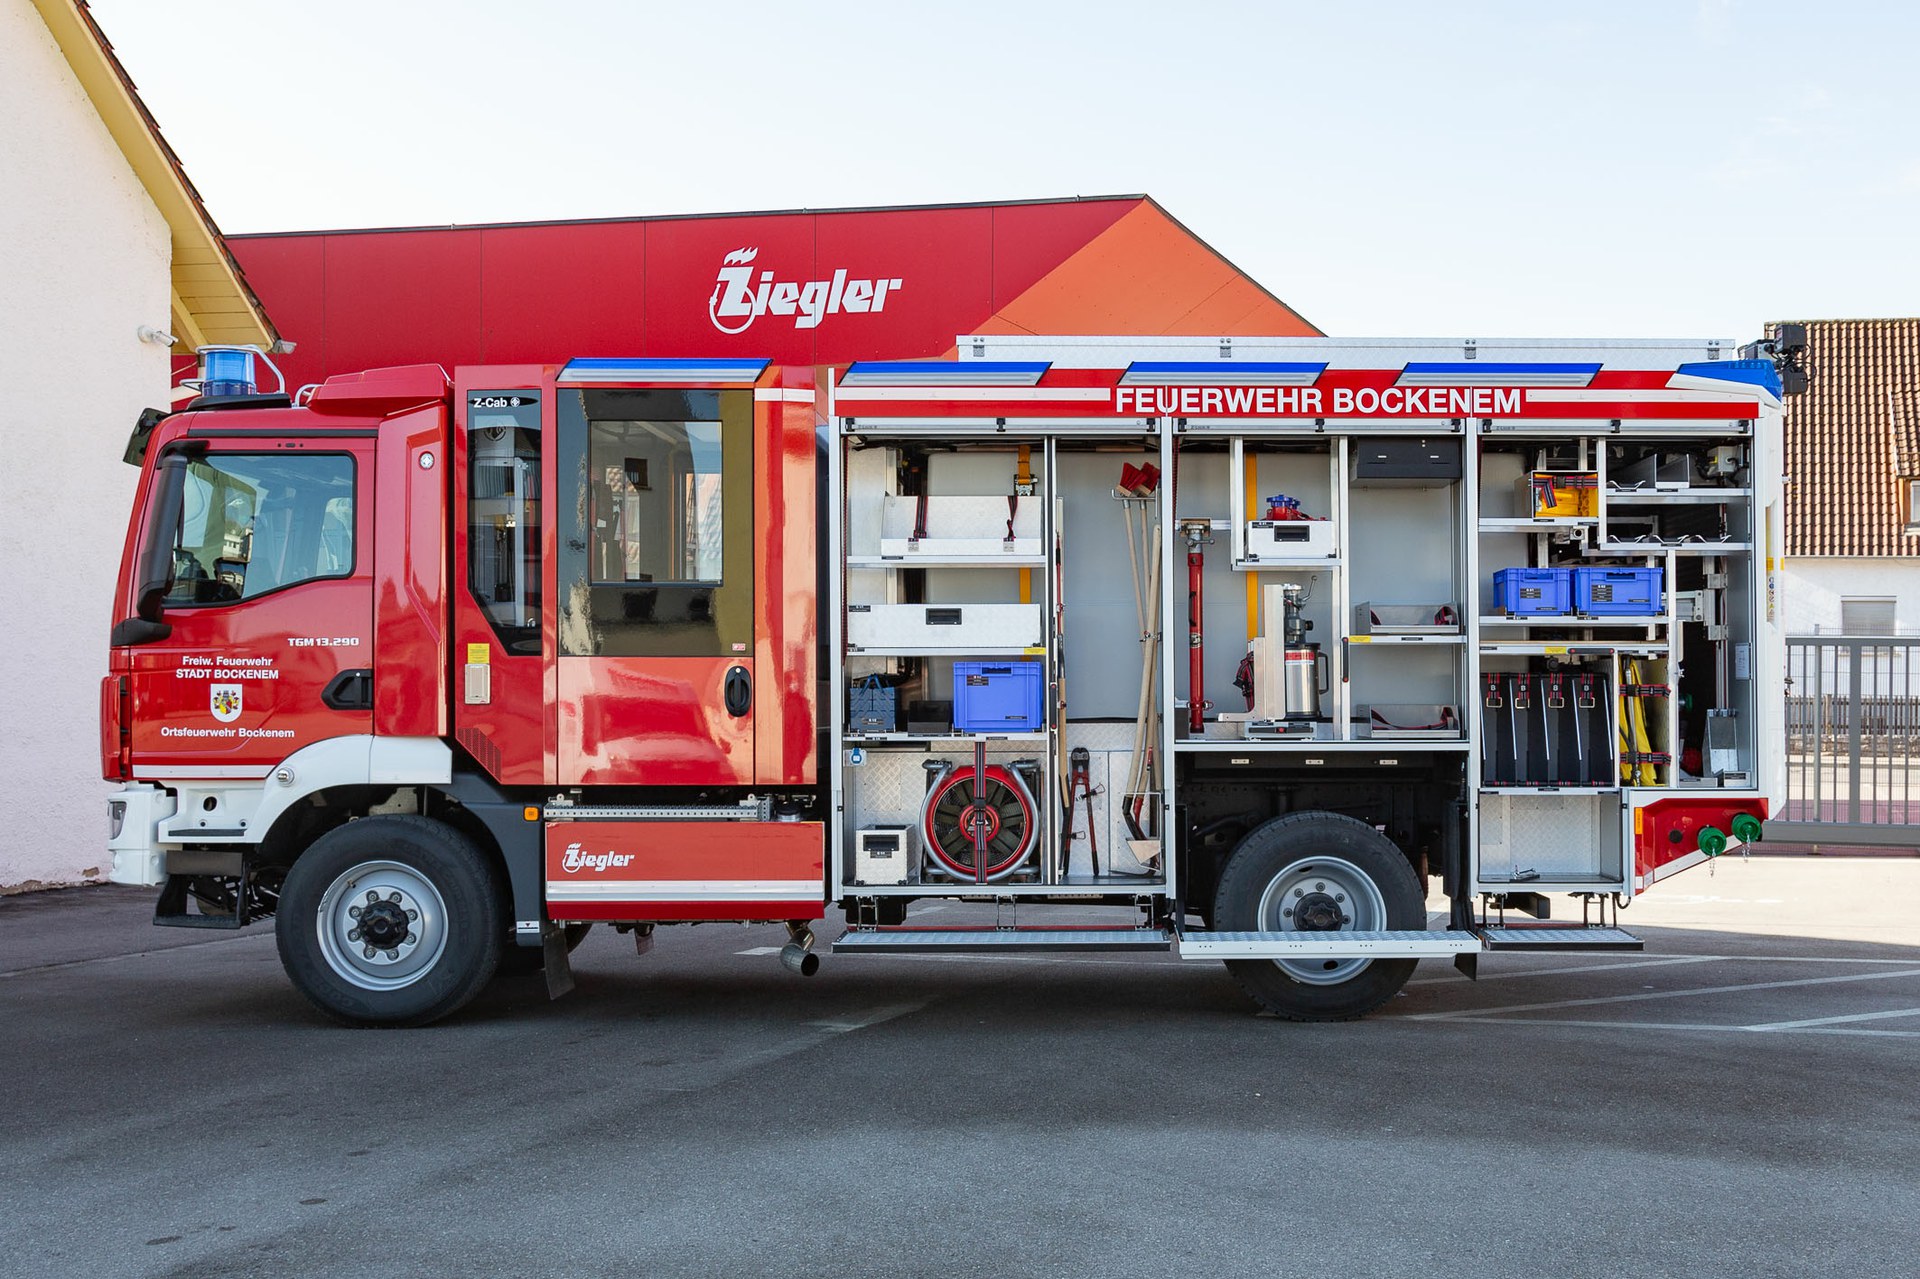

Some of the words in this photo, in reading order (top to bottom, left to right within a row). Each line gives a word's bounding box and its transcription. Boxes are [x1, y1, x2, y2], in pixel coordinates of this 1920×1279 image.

[709, 263, 903, 334] Ziegler
[473, 397, 508, 408] Z-Cab
[1115, 387, 1322, 414] FEUERWEHR
[1333, 387, 1521, 414] BOCKENEM
[182, 655, 214, 667] Freiw.
[216, 656, 273, 667] Feuerwehr
[175, 669, 211, 680] STADT
[213, 669, 279, 680] BOCKENEM
[160, 726, 236, 738] Ortsfeuerwehr
[238, 727, 295, 738] Bockenem
[562, 847, 635, 873] Ziegler
